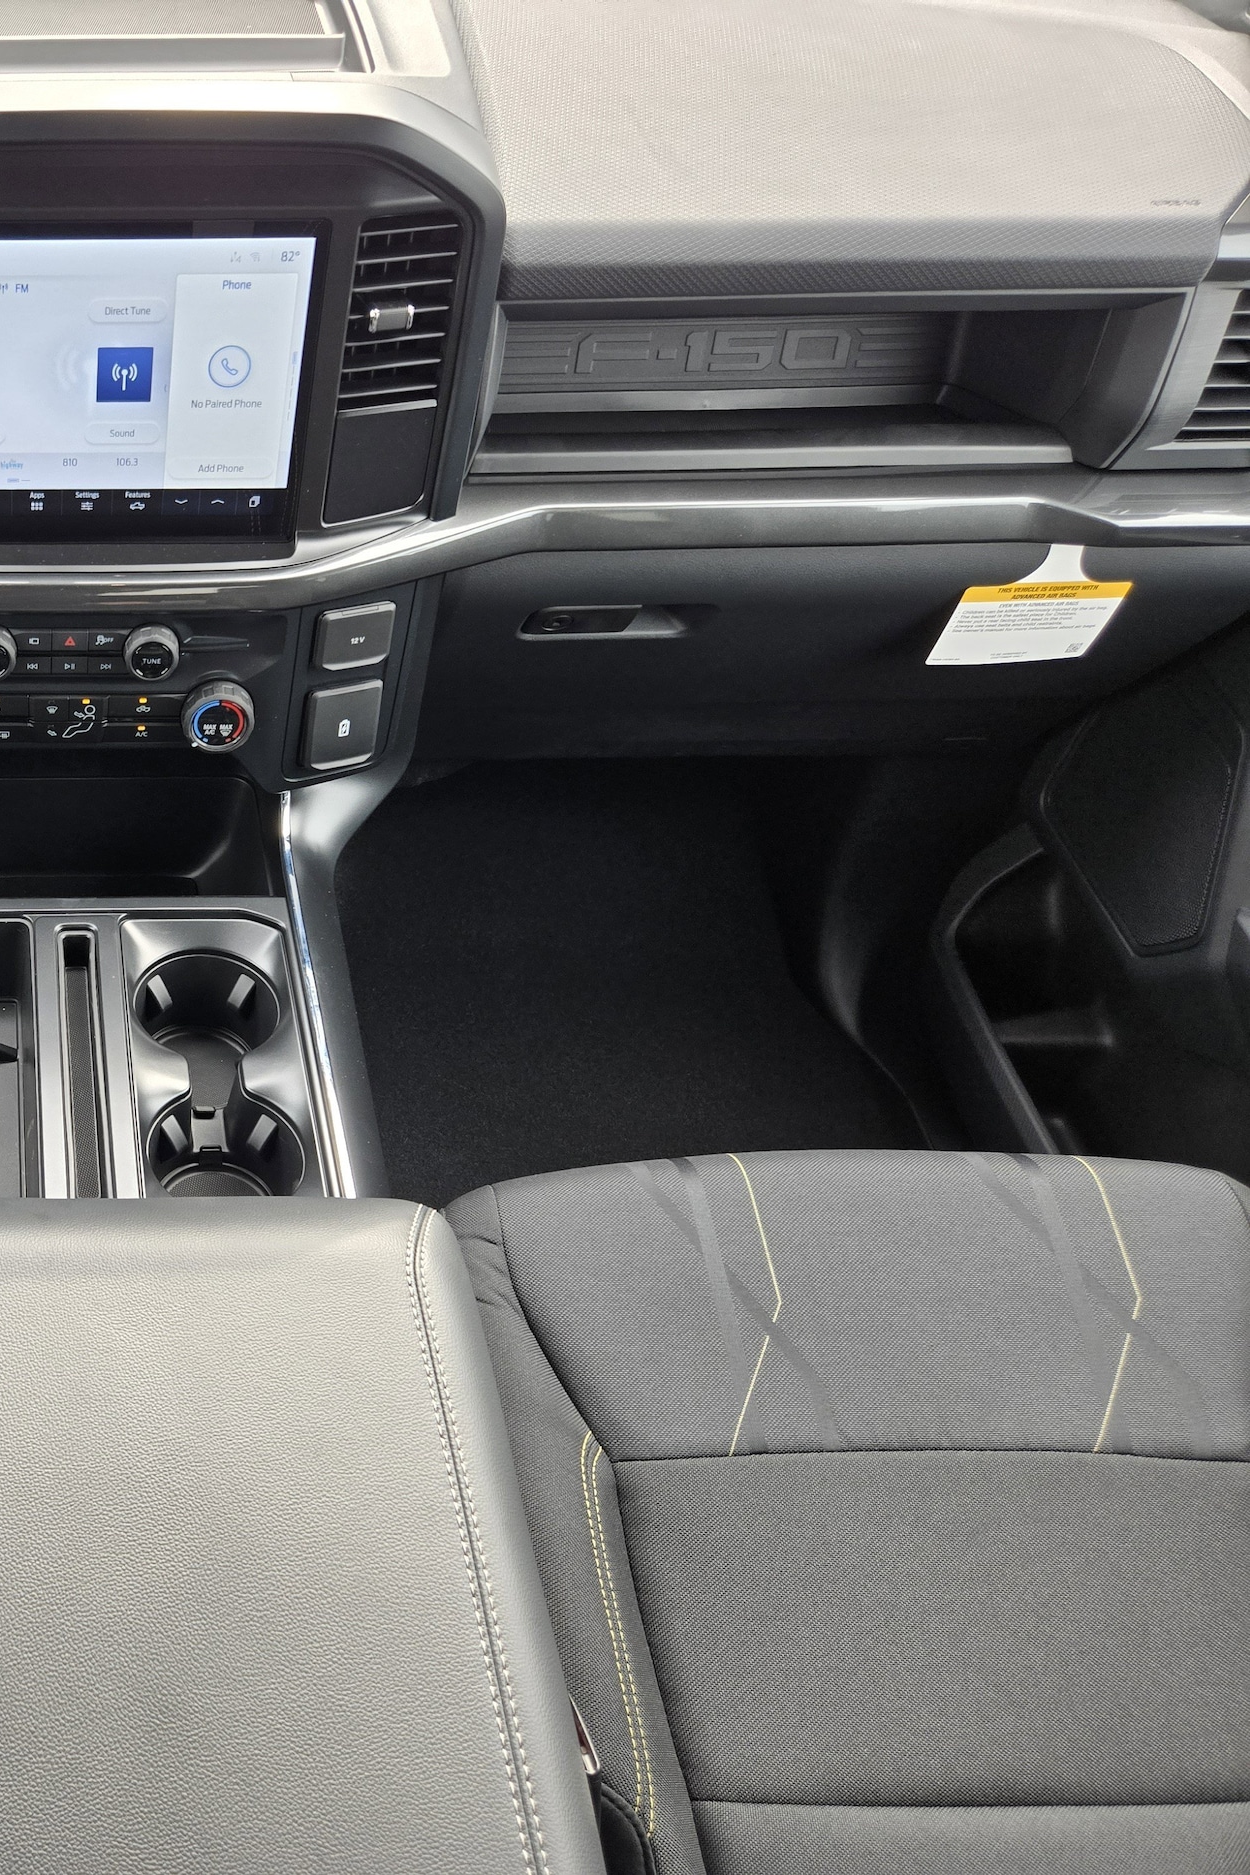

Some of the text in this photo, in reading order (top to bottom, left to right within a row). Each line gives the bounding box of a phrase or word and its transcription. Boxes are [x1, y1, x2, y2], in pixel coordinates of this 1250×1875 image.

[15, 284, 30, 293] FM
[222, 280, 252, 290] Phone
[104, 306, 151, 316] Direct Tune
[574, 327, 852, 375] F-150
[191, 399, 262, 409] No Paired Phone
[109, 428, 135, 438] Sound
[62, 457, 78, 467] 810
[116, 457, 139, 467] 106.3
[197, 463, 245, 473] Add Phone
[29, 491, 45, 501] Apps
[75, 491, 100, 501] Settings
[124, 490, 151, 499] Features
